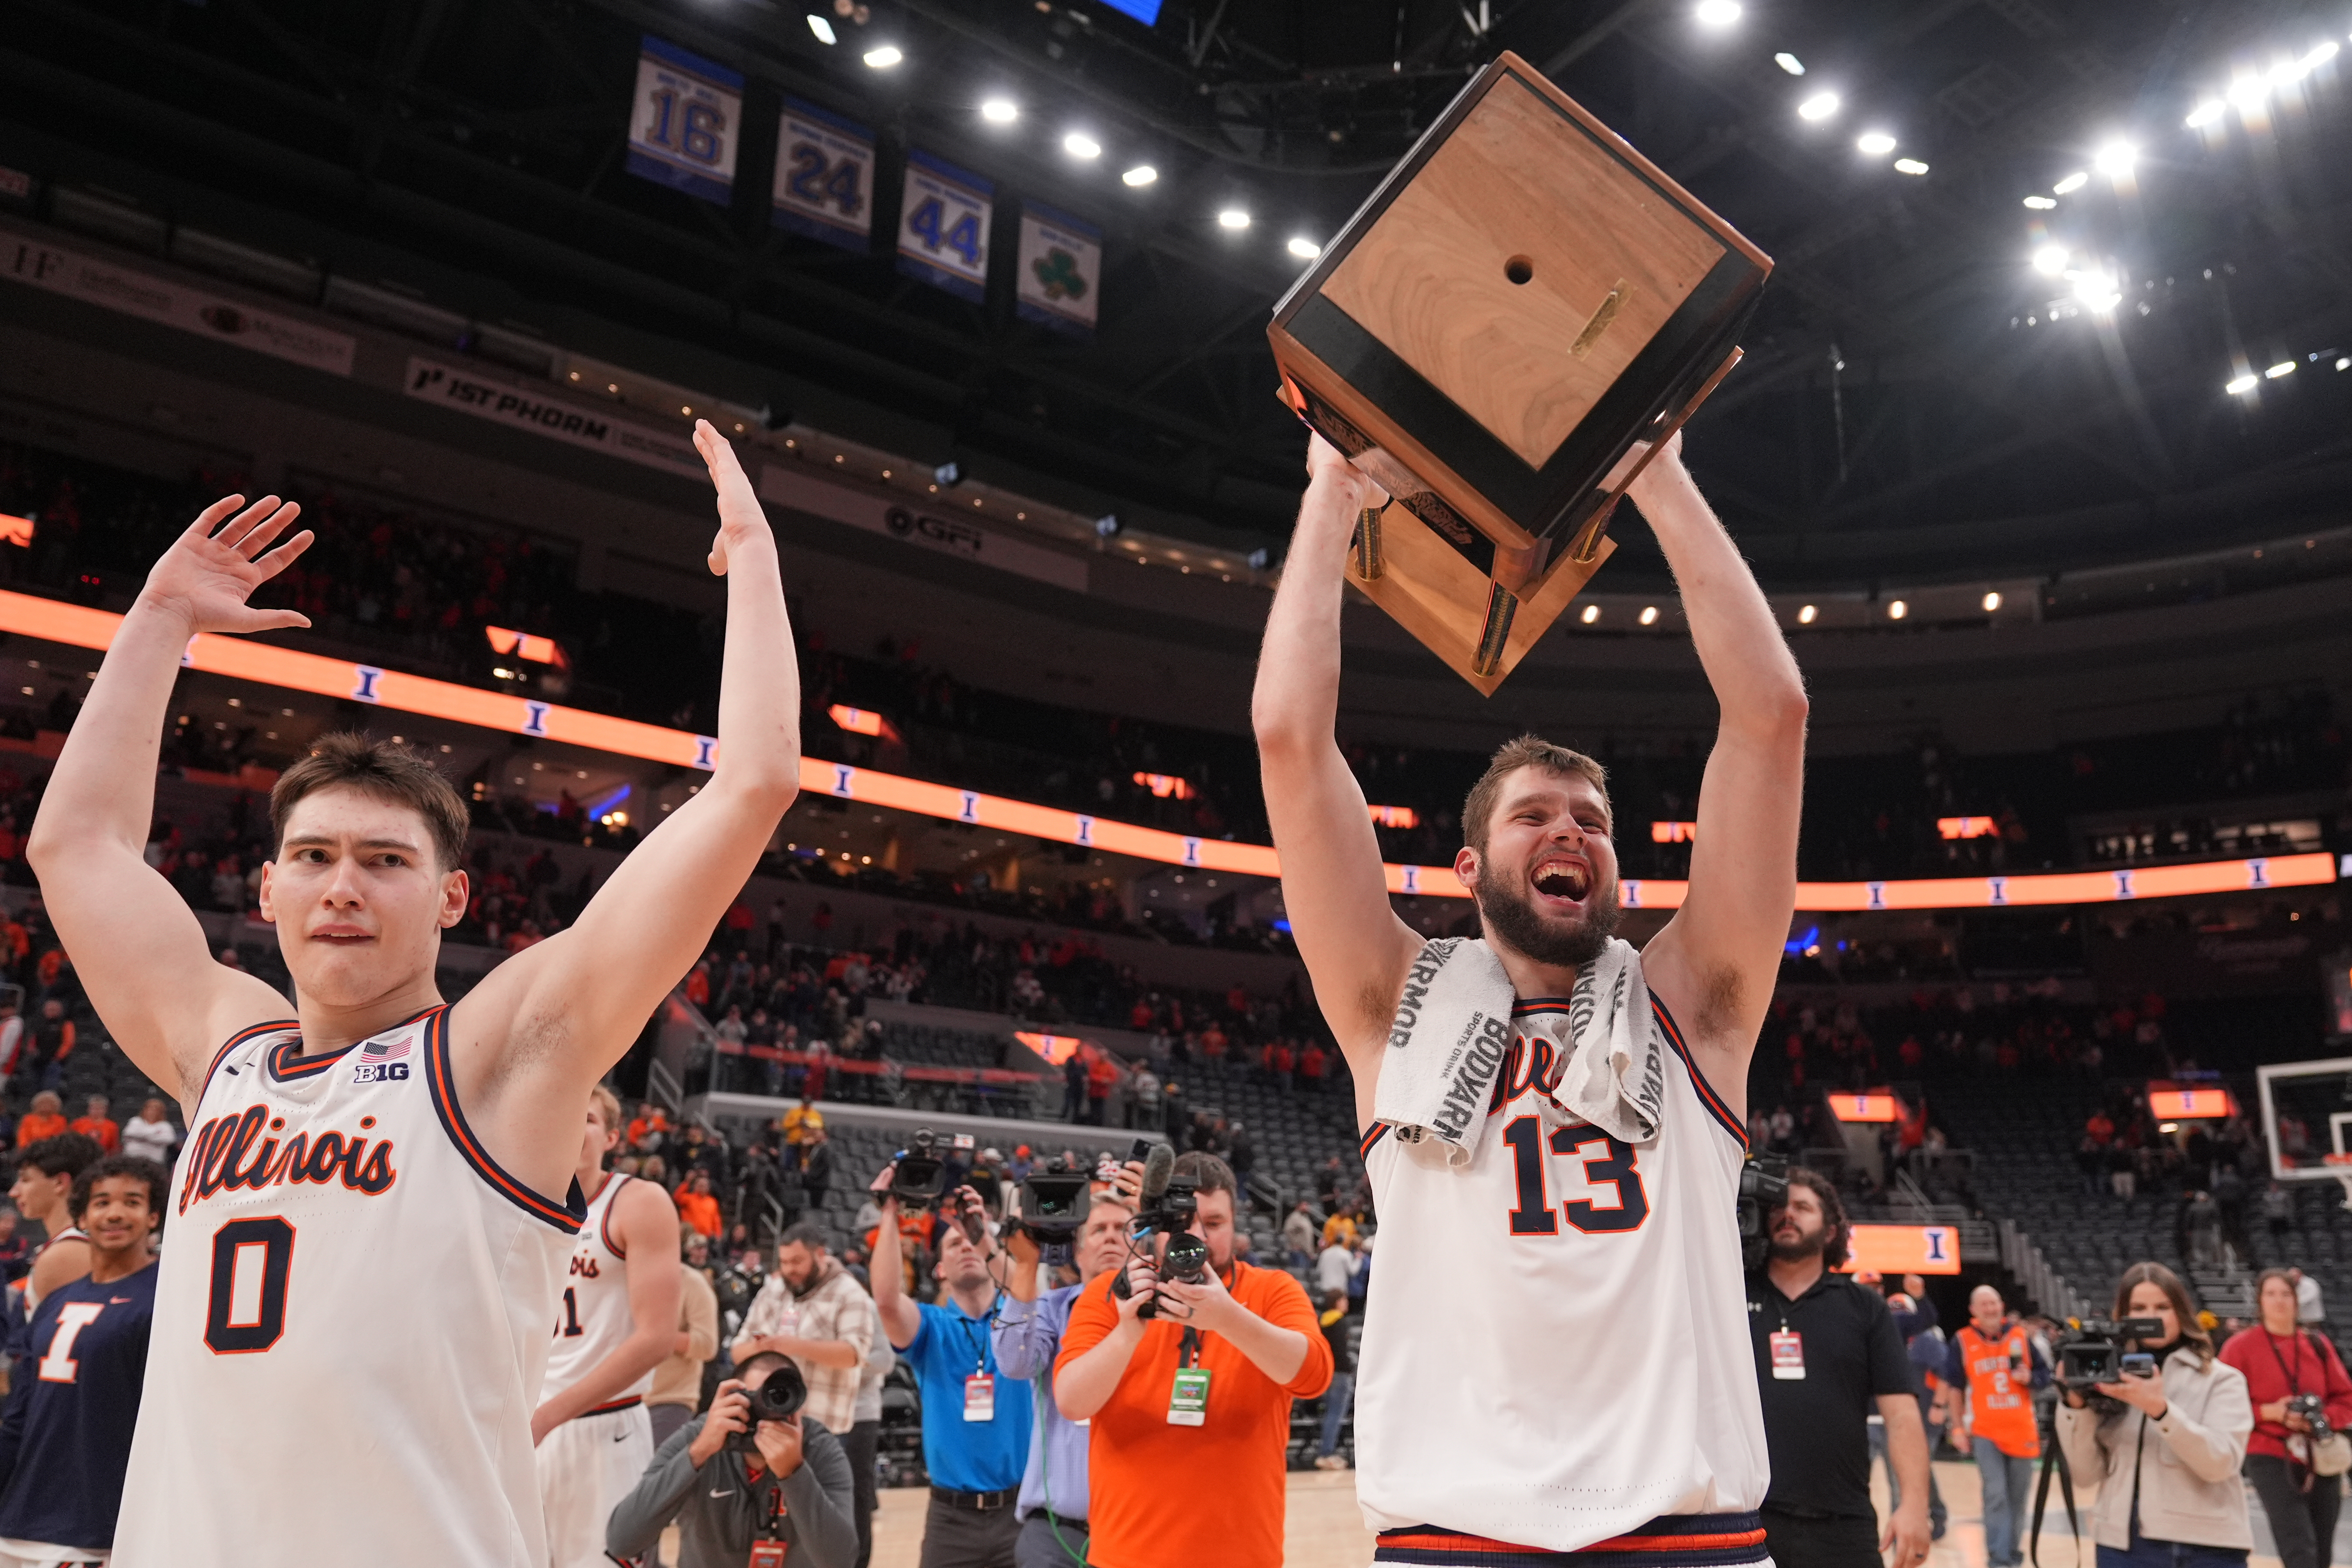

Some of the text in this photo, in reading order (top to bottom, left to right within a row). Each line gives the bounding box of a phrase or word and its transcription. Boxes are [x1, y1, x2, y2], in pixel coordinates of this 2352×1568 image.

[646, 88, 726, 166] 16
[785, 140, 864, 216] 24
[910, 194, 982, 270] 44
[496, 394, 608, 440] PHORM
[178, 1103, 397, 1217] Illinois
[1503, 1114, 1650, 1236] 13
[203, 1214, 297, 1355] 0
[1926, 1230, 1947, 1262] I
[38, 1302, 104, 1384] I
[1994, 1371, 2010, 1394] 2
